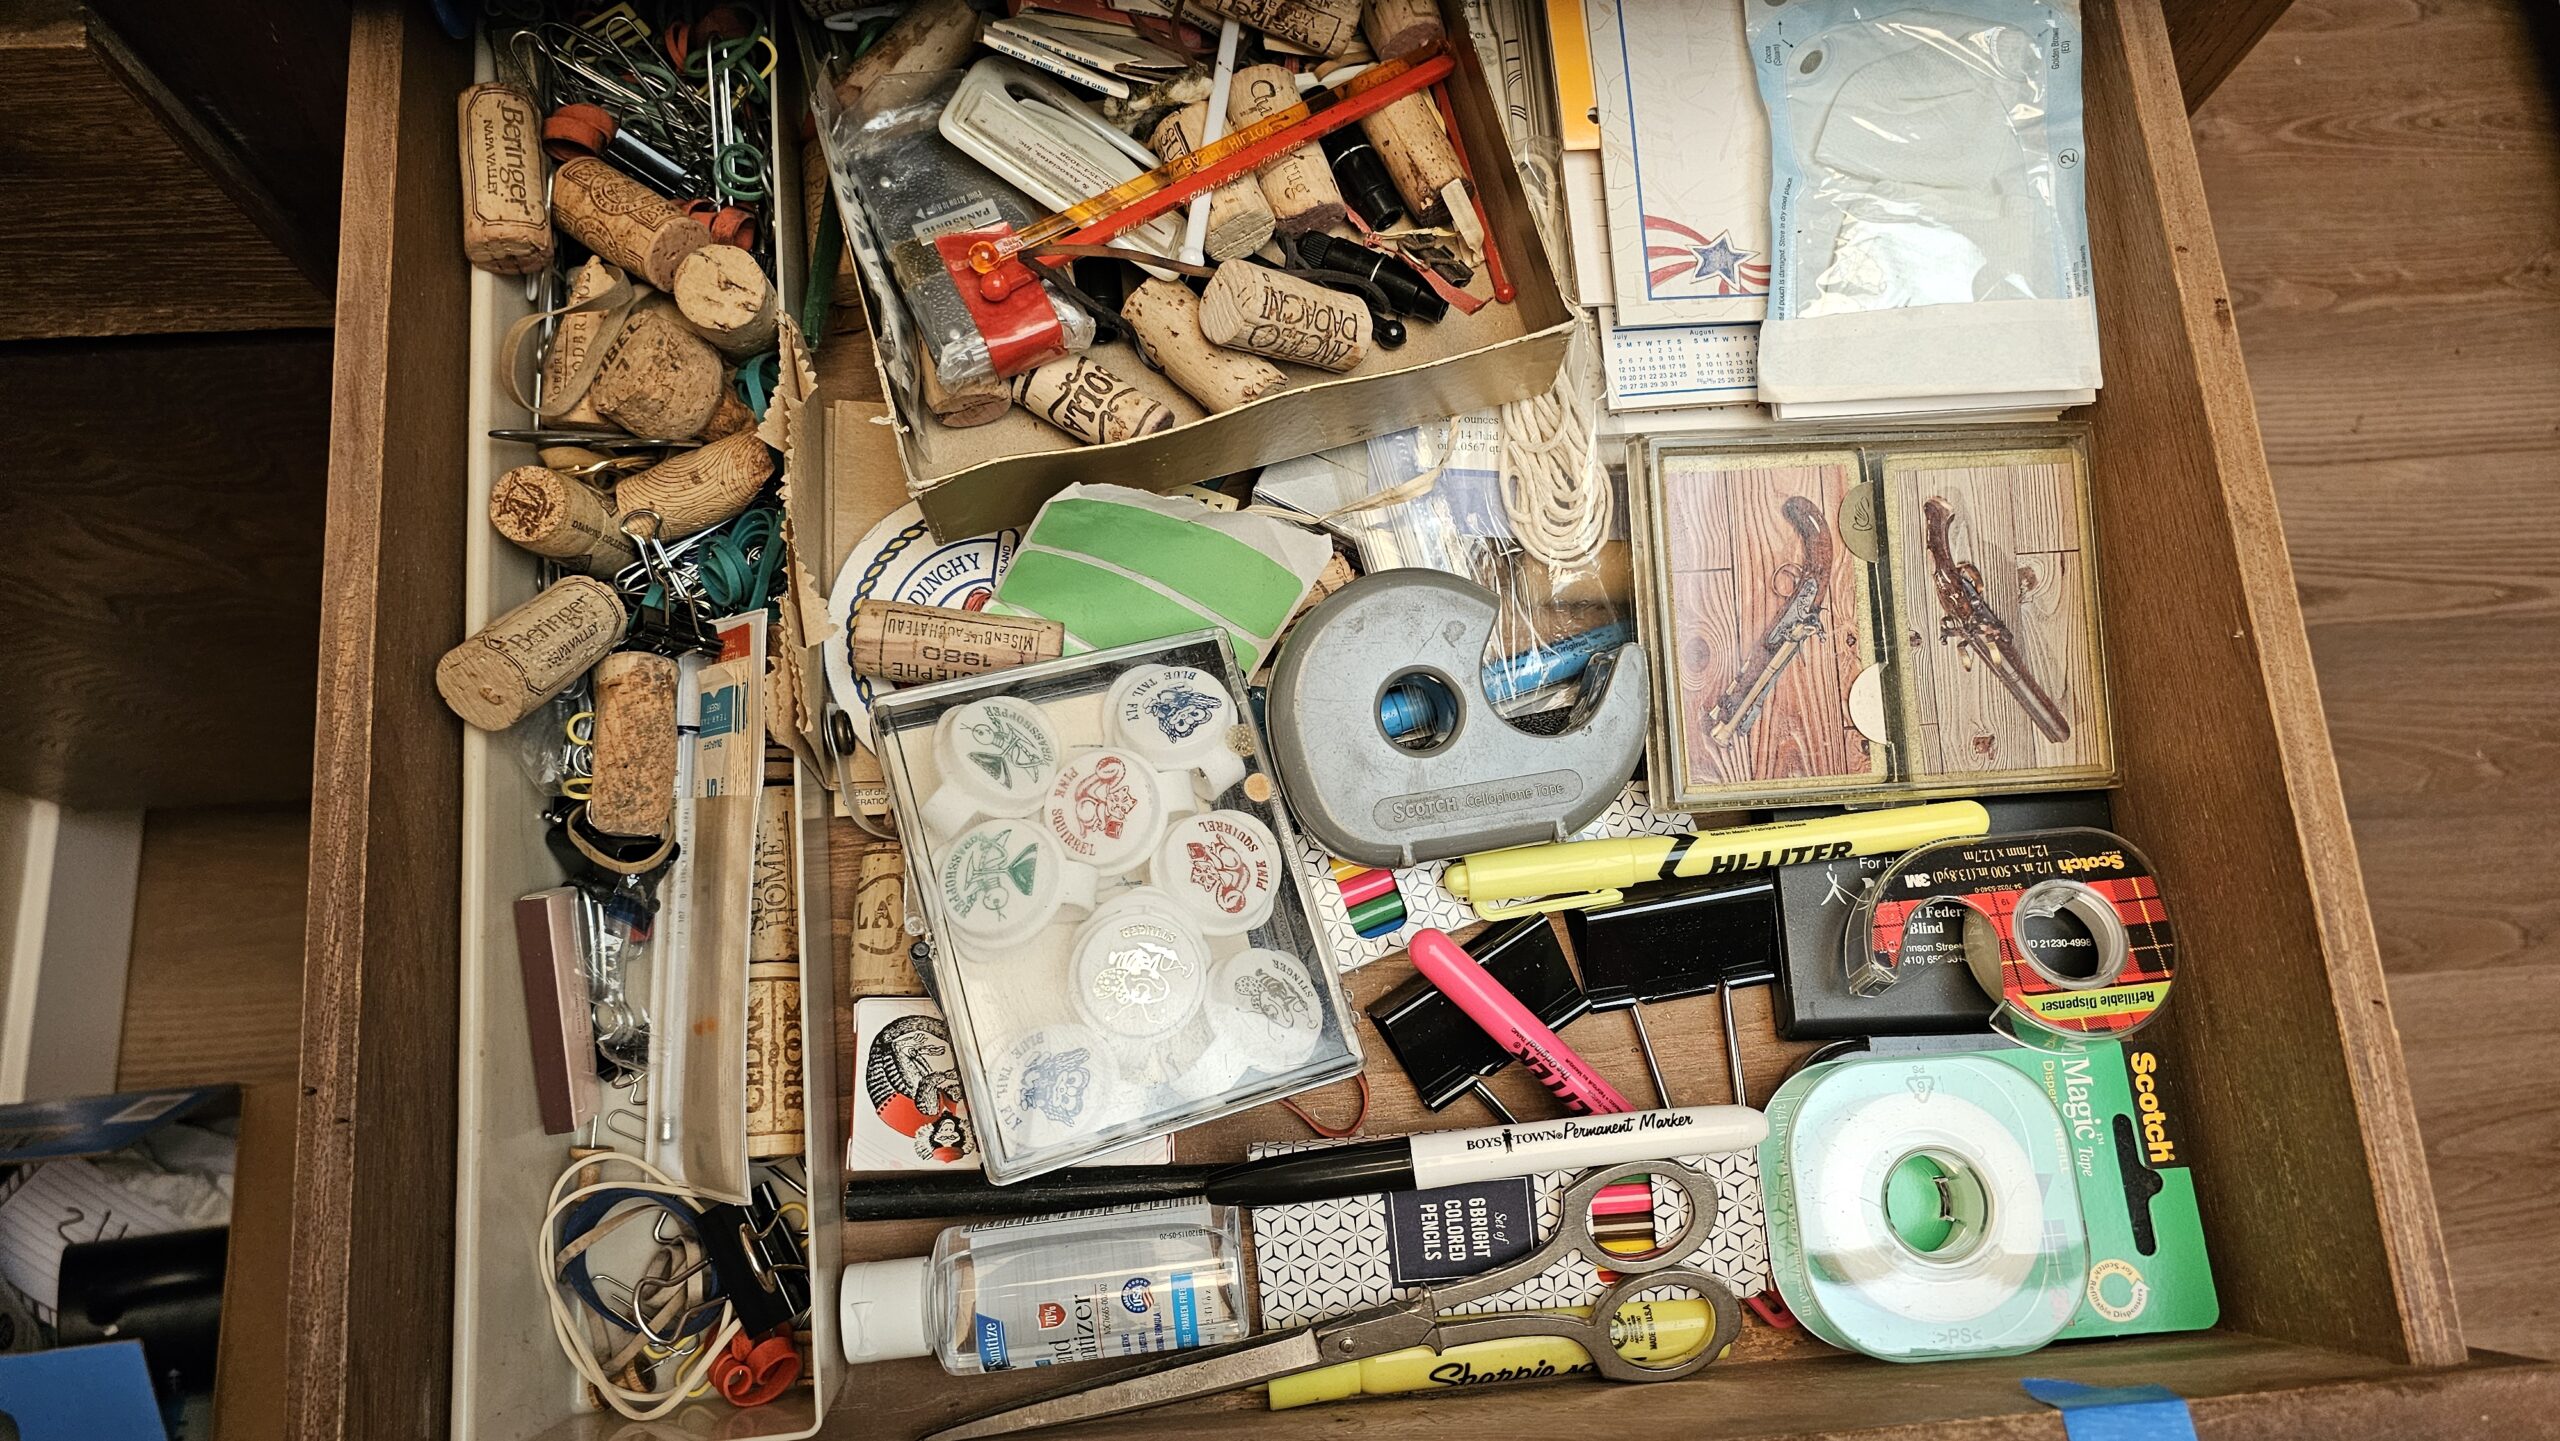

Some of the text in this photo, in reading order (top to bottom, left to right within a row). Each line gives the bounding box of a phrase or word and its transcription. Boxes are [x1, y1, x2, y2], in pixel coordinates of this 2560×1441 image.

[484, 120, 498, 196] NAPA VALLEY
[500, 102, 531, 216] Beringer
[1189, 181, 1223, 200] CHINA
[923, 207, 991, 235] PANASONIC
[1689, 328, 1714, 336] August
[551, 349, 563, 401] OBERT
[1464, 416, 1499, 425] ounces
[999, 544, 1012, 577] ISLAND
[907, 551, 981, 606] DINGHY
[507, 593, 588, 653] Beringer
[570, 621, 599, 649] VALLEY
[922, 645, 992, 667] 1980
[1124, 670, 1197, 722] BLUE TAIL FLY
[1051, 766, 1097, 857] PINK SQUIRREL
[1392, 783, 1565, 823] SCOTCH Cellophane Tape
[1198, 820, 1268, 891] PINK SQUIRREL
[1708, 840, 1854, 876] HI-LITER
[1859, 857, 1881, 870] For
[1963, 849, 1997, 864] 12,7m
[2012, 844, 2049, 859] 12,7mm
[2034, 860, 2054, 874] 1/2
[2058, 854, 2125, 874] Scotch
[763, 838, 788, 929] HOME
[1904, 873, 1931, 889] 3M
[1989, 865, 2011, 879] 500
[1909, 922, 1944, 935] Blind
[1271, 958, 1314, 998] STINGER
[2041, 989, 2155, 1012] Refillable Dispenser
[746, 997, 764, 1114] CEDAR
[783, 998, 803, 1112] BROOK
[1011, 1031, 1045, 1059] BLUE
[1467, 1135, 1502, 1150] BOYS
[1564, 1117, 1635, 1140] Permanent
[1640, 1112, 1694, 1132] Marker
[2078, 1146, 2094, 1178] Tape
[1420, 1203, 1441, 1261] PENCILS
[1444, 1199, 1466, 1262] COLORED
[1495, 1211, 1509, 1246] Set of
[1045, 1304, 1057, 1327] 70%
[2089, 1280, 2113, 1317] Refillable
[2113, 1288, 2144, 1319] Dispensers
[986, 1322, 1003, 1367] Sanitize
[1649, 1332, 1657, 1350] MADE
[1429, 1360, 1556, 1386] Sharpie
